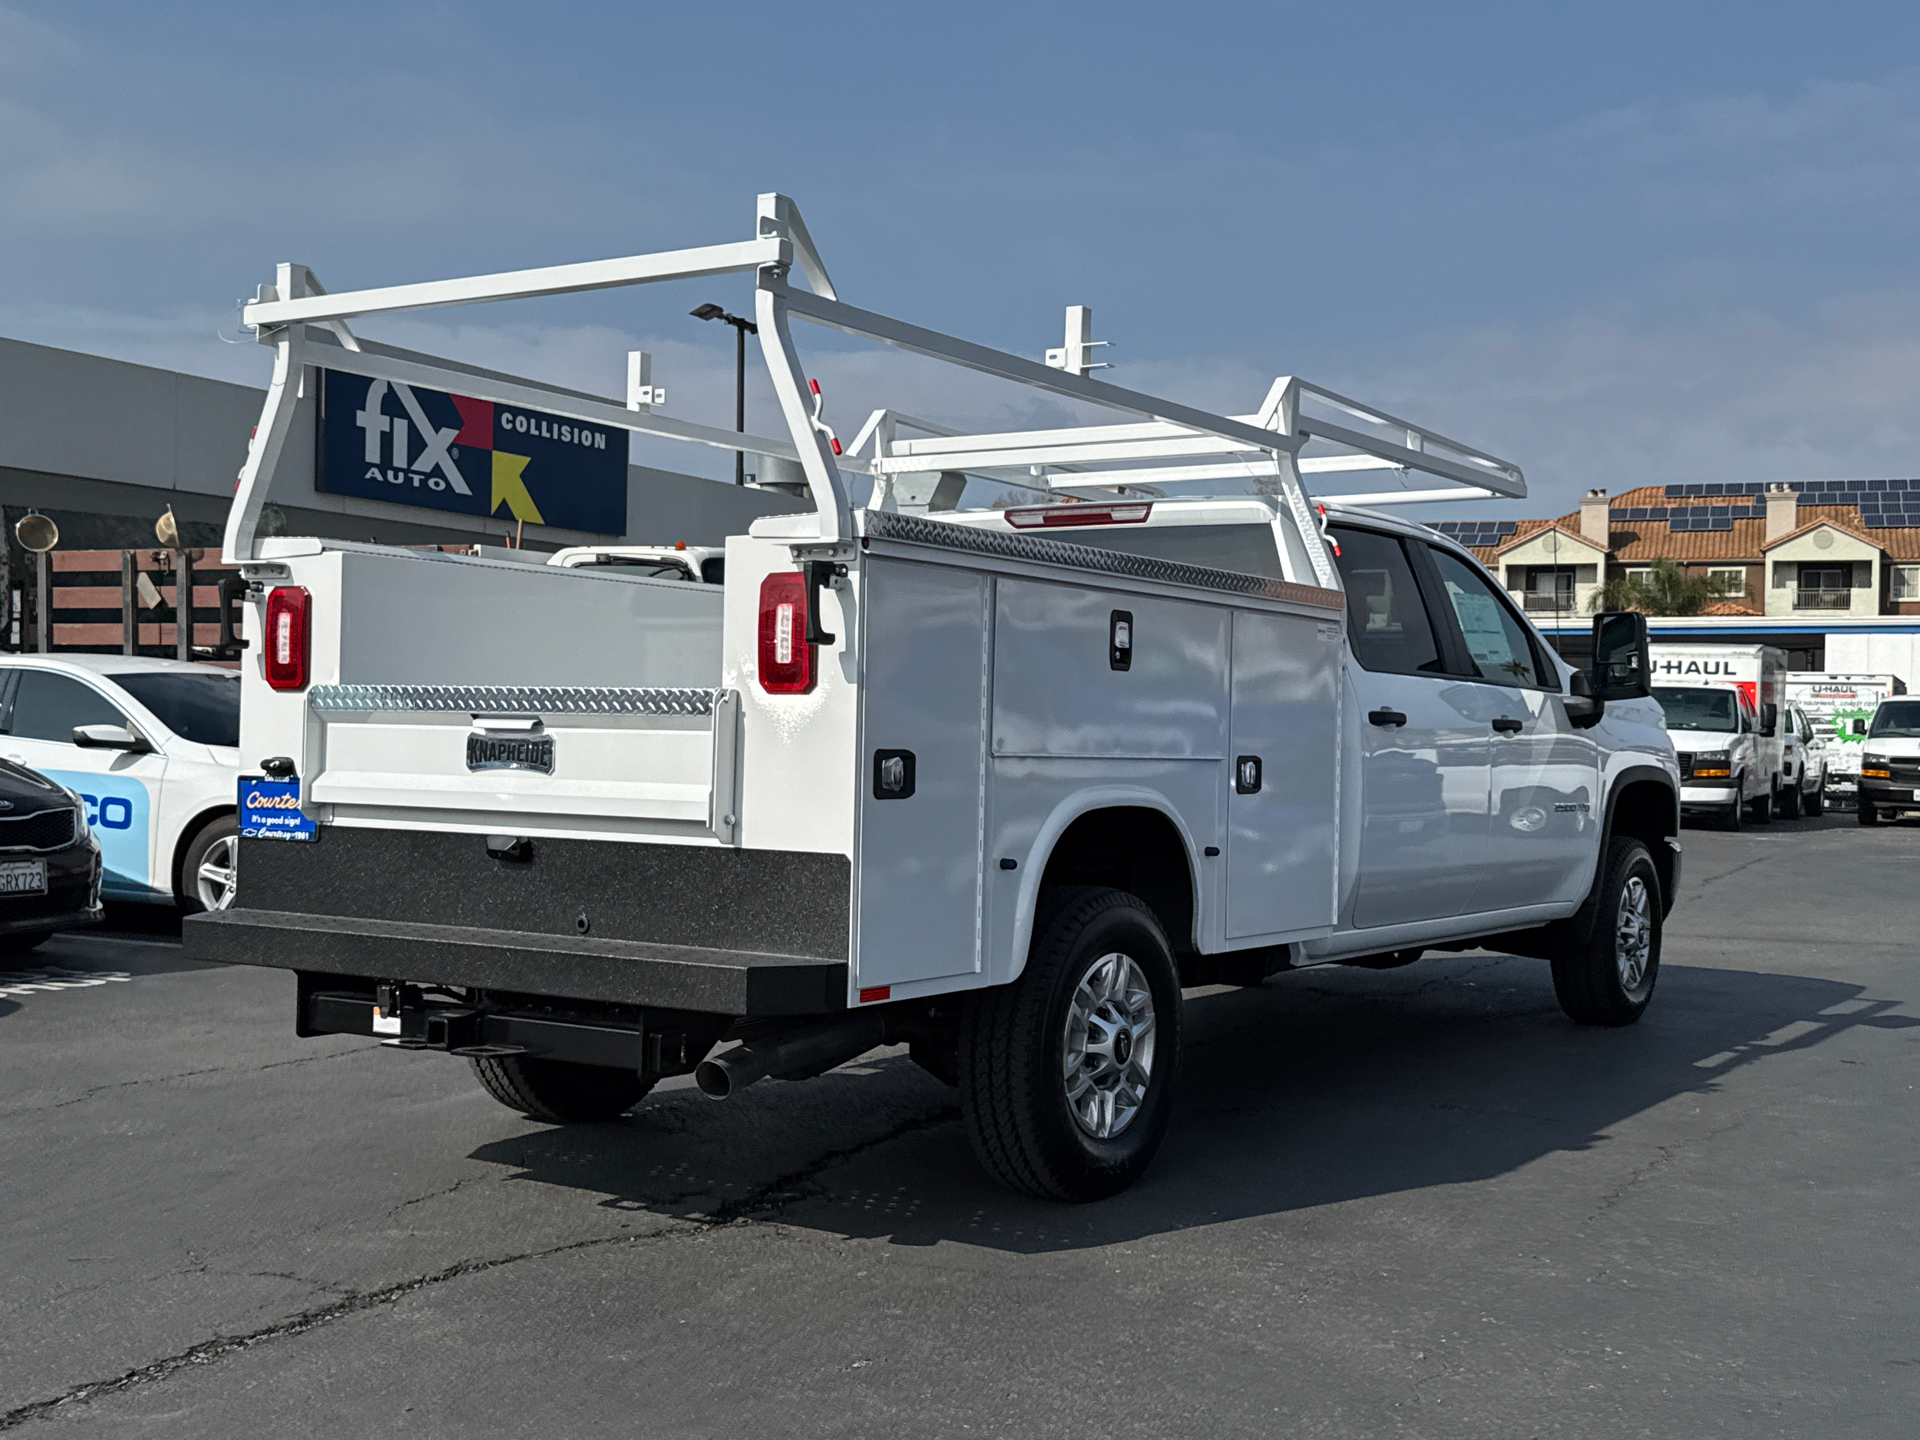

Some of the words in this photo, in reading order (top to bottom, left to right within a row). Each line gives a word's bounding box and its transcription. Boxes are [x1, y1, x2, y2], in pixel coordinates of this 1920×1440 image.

[356, 378, 473, 496] fix
[501, 411, 606, 451] COLLISION
[364, 466, 447, 491] AUTO
[1811, 685, 1856, 694] U-HAUL
[468, 738, 552, 767] KNAPHEIDE
[266, 815, 284, 827] good
